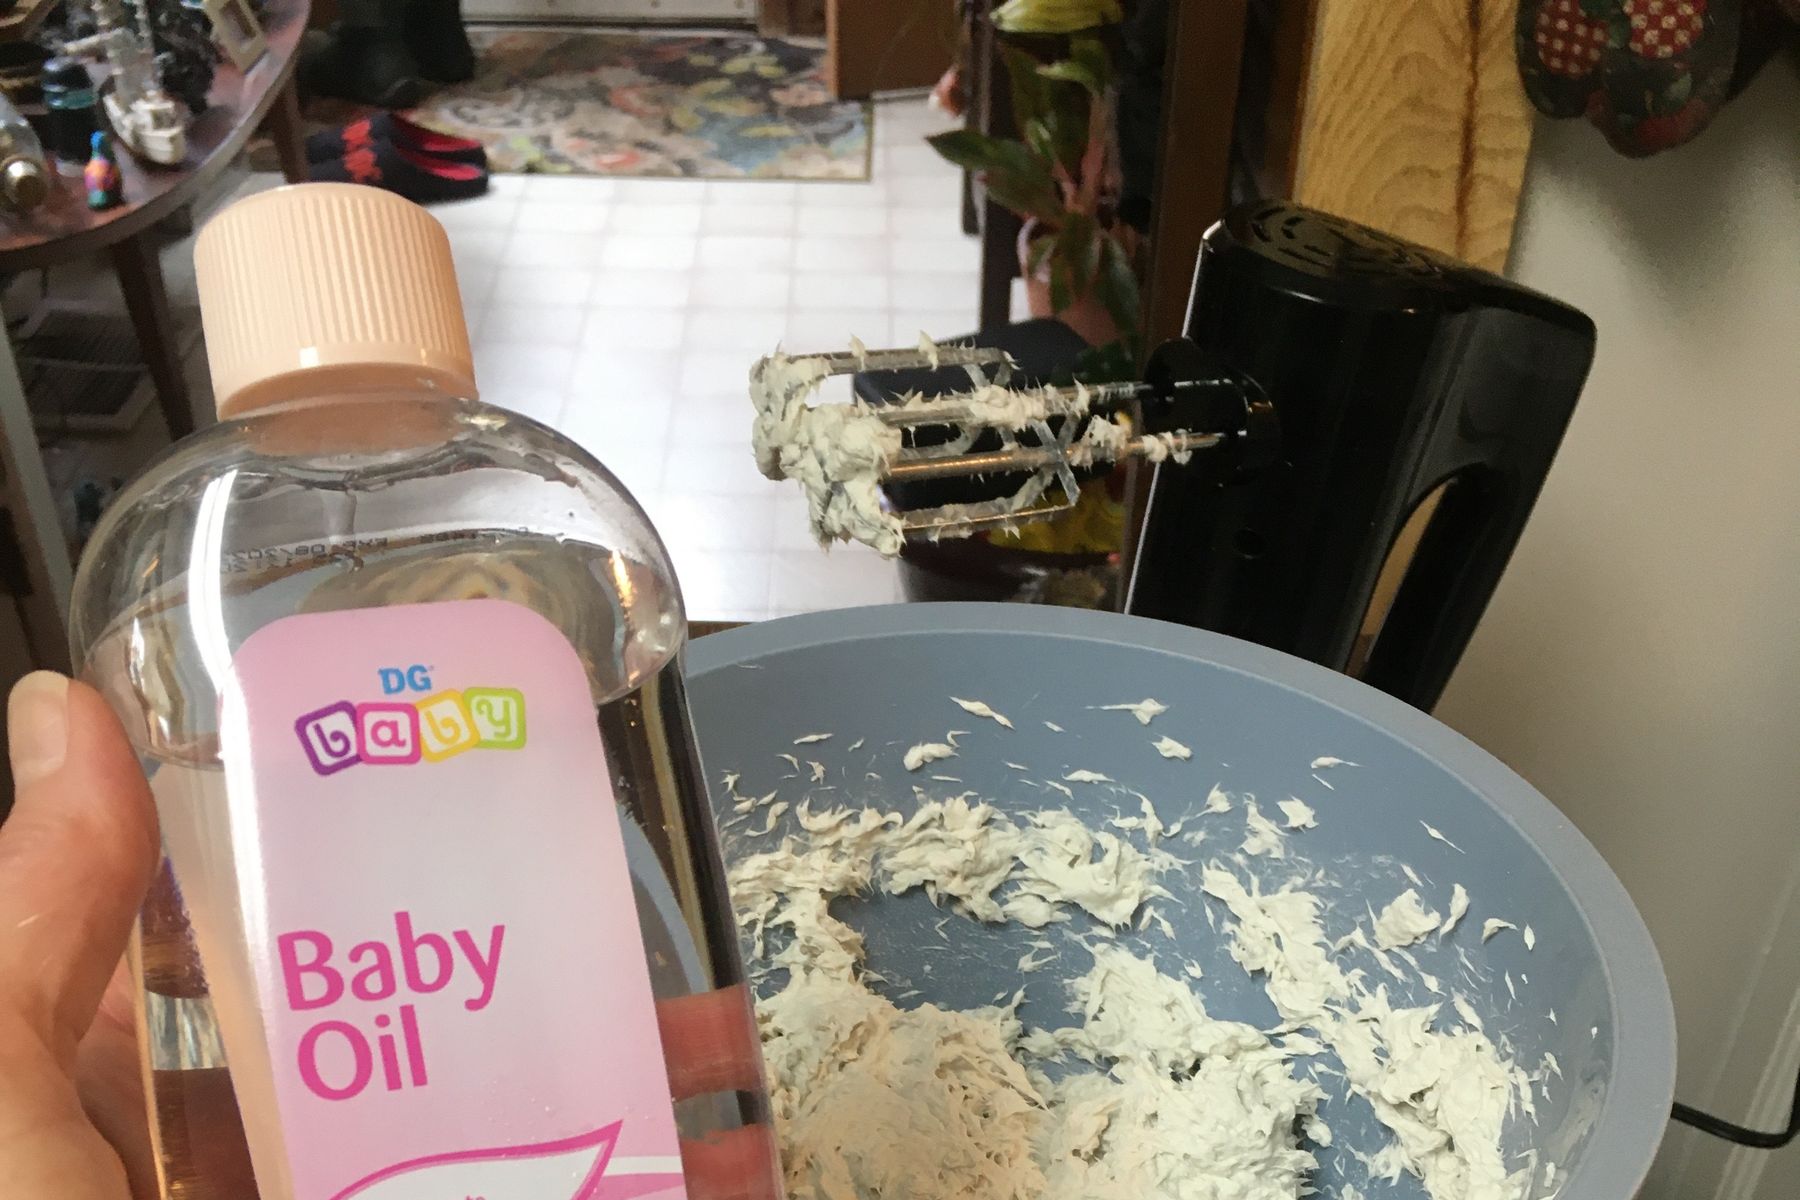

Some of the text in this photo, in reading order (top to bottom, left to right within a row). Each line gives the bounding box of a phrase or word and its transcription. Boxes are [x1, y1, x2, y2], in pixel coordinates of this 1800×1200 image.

[378, 664, 432, 695] DG
[306, 692, 519, 766] baby
[277, 911, 505, 1011] Baby
[297, 1005, 428, 1101] Oil
